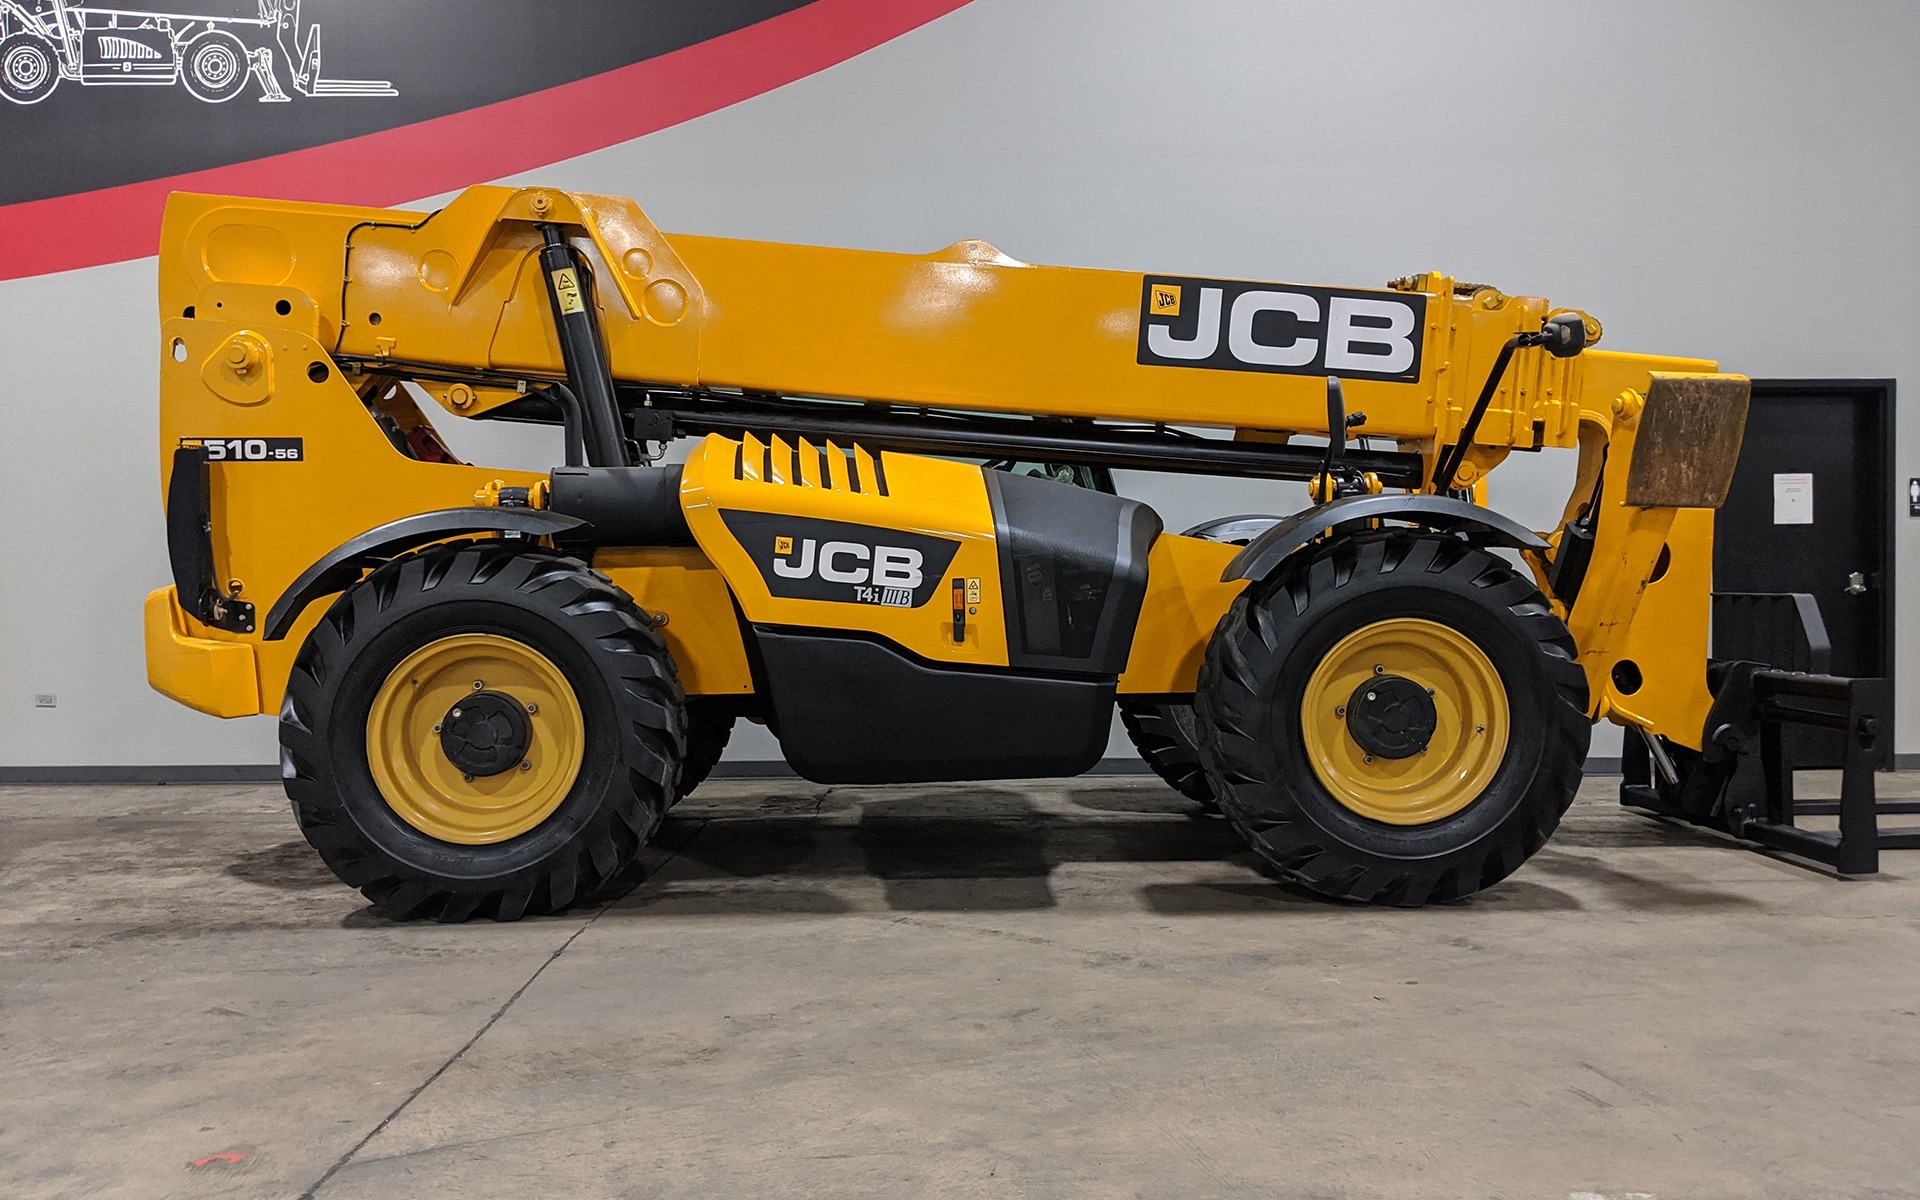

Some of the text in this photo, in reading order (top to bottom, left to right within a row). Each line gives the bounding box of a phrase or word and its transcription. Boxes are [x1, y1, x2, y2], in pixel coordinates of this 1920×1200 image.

[1158, 292, 1176, 307] JCB
[1147, 287, 1415, 373] JCB
[204, 440, 299, 460] 510-56
[773, 538, 923, 589] JCB
[853, 585, 880, 603] T4i
